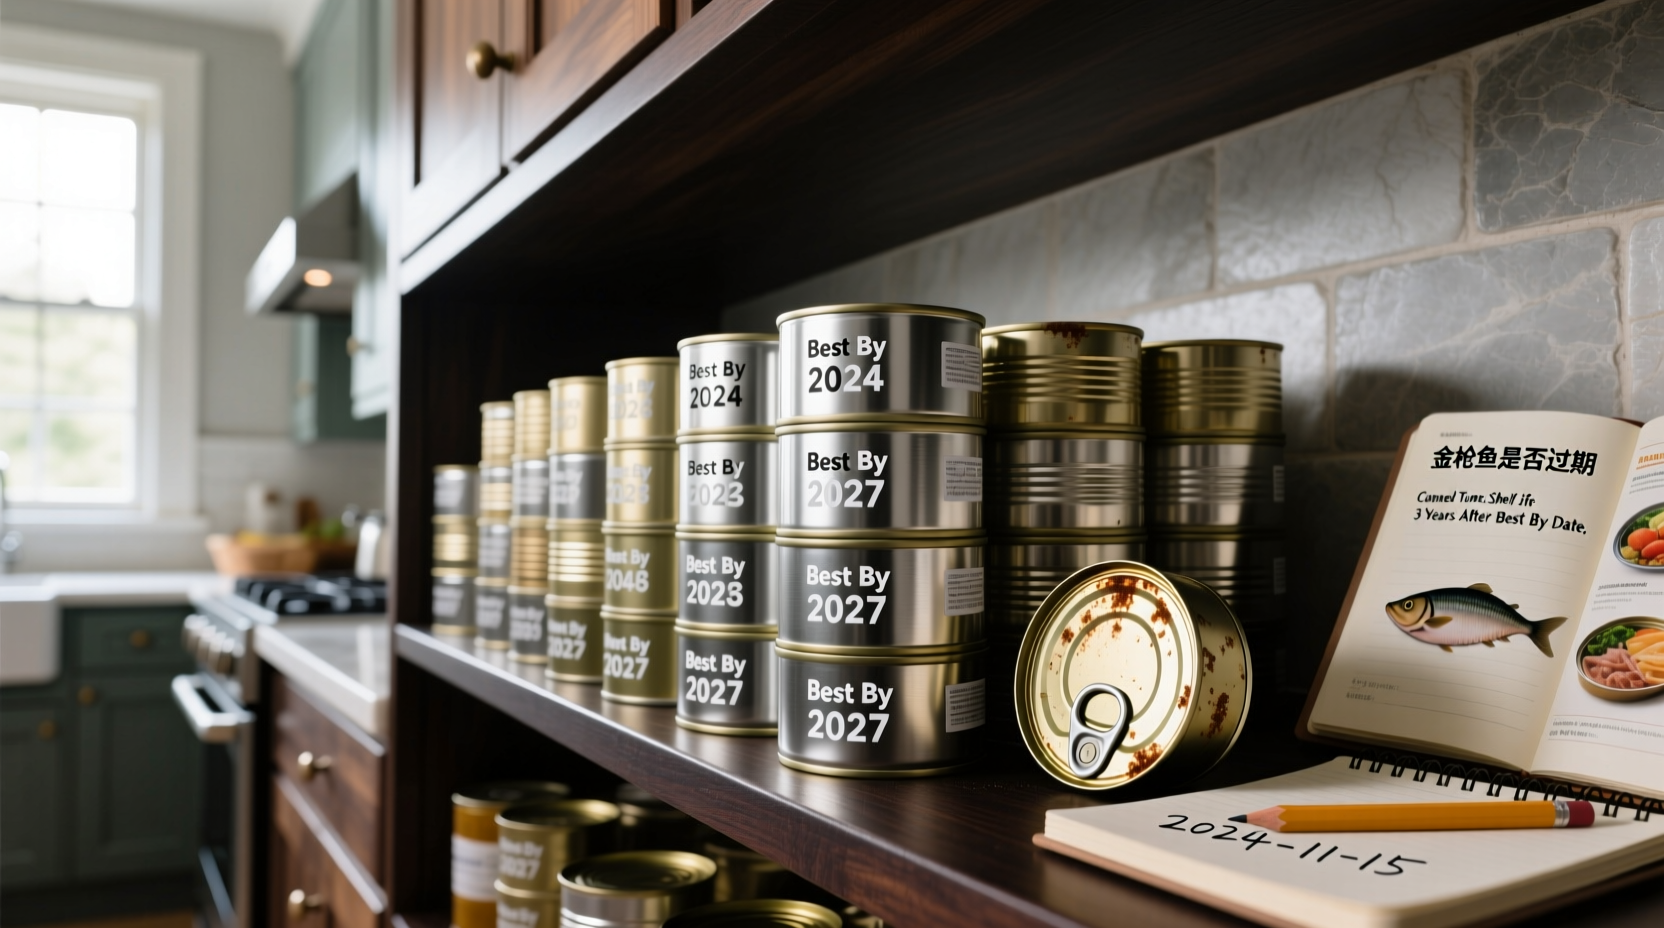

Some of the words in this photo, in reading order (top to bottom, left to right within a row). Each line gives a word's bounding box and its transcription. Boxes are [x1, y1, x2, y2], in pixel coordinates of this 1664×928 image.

[807, 337, 850, 358] Best
[857, 335, 887, 361] By
[689, 362, 717, 380] Best
[723, 360, 746, 381] By
[808, 364, 884, 393] 2024
[690, 384, 742, 409] 2024
[688, 460, 717, 476] Best
[722, 458, 745, 479] By
[807, 451, 850, 472] Best
[857, 450, 888, 476] By
[688, 481, 744, 508] 2023
[807, 479, 885, 508] 2027
[1413, 508, 1422, 521] 3
[1425, 508, 1456, 521] Years
[1458, 509, 1491, 523] After
[1495, 511, 1526, 526] Best
[1529, 513, 1549, 532] By
[1551, 515, 1587, 535] Date.
[631, 548, 650, 569] By
[686, 554, 717, 574] Best
[721, 556, 746, 580] By
[806, 564, 852, 587] Best
[859, 565, 891, 593] By
[807, 593, 887, 625] 2027
[630, 636, 650, 657] By
[603, 652, 649, 680] 2027
[685, 650, 718, 673] Best
[721, 654, 747, 679] By
[685, 675, 744, 706] 2027
[807, 679, 855, 704] Best
[861, 682, 894, 710] By
[807, 709, 890, 743] 2027
[1159, 813, 1427, 876] 2024-11-15
